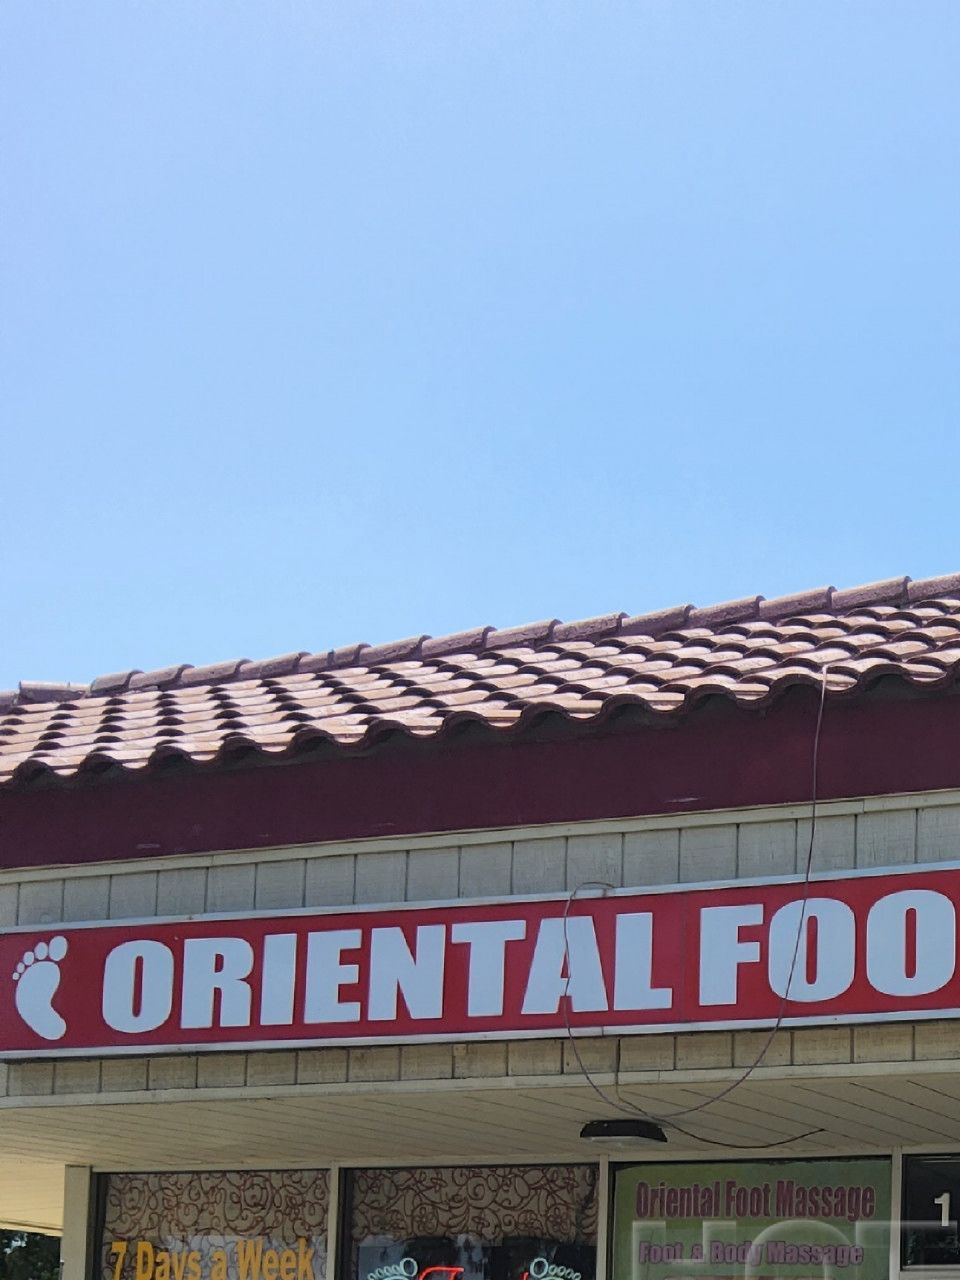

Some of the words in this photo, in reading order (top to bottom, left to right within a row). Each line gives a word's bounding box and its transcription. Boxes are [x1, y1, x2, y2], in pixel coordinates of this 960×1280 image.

[102, 913, 673, 1034] ORIENTAL
[636, 1181, 721, 1219] Oriental
[725, 1181, 770, 1219] Foot
[776, 1181, 875, 1221] Massage
[638, 1241, 682, 1264] Foot
[710, 1241, 762, 1267] Body
[766, 1241, 864, 1267] Massage
